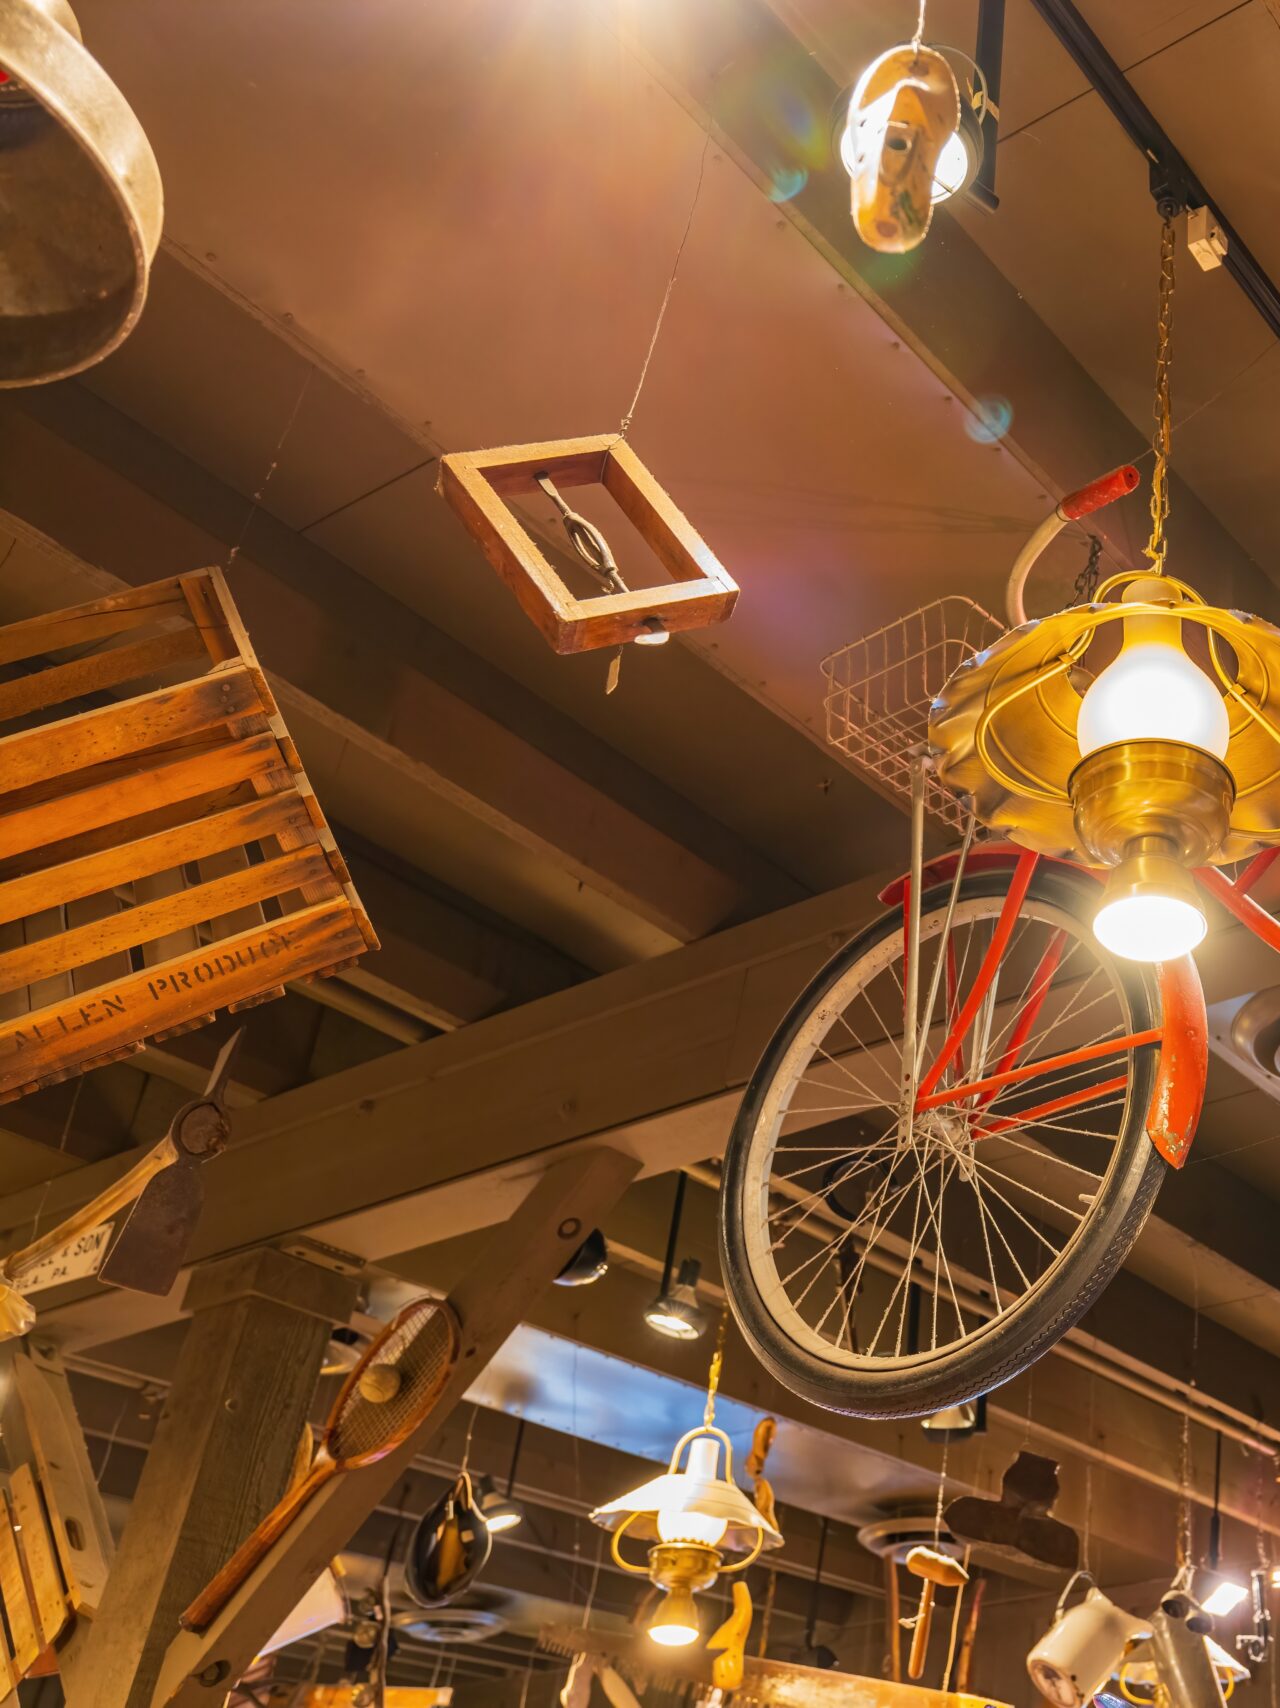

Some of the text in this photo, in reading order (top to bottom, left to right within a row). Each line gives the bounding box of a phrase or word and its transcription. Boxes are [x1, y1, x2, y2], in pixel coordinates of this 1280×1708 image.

[15, 930, 304, 1052] ALLEN PRODUCE
[73, 1230, 107, 1257] SON
